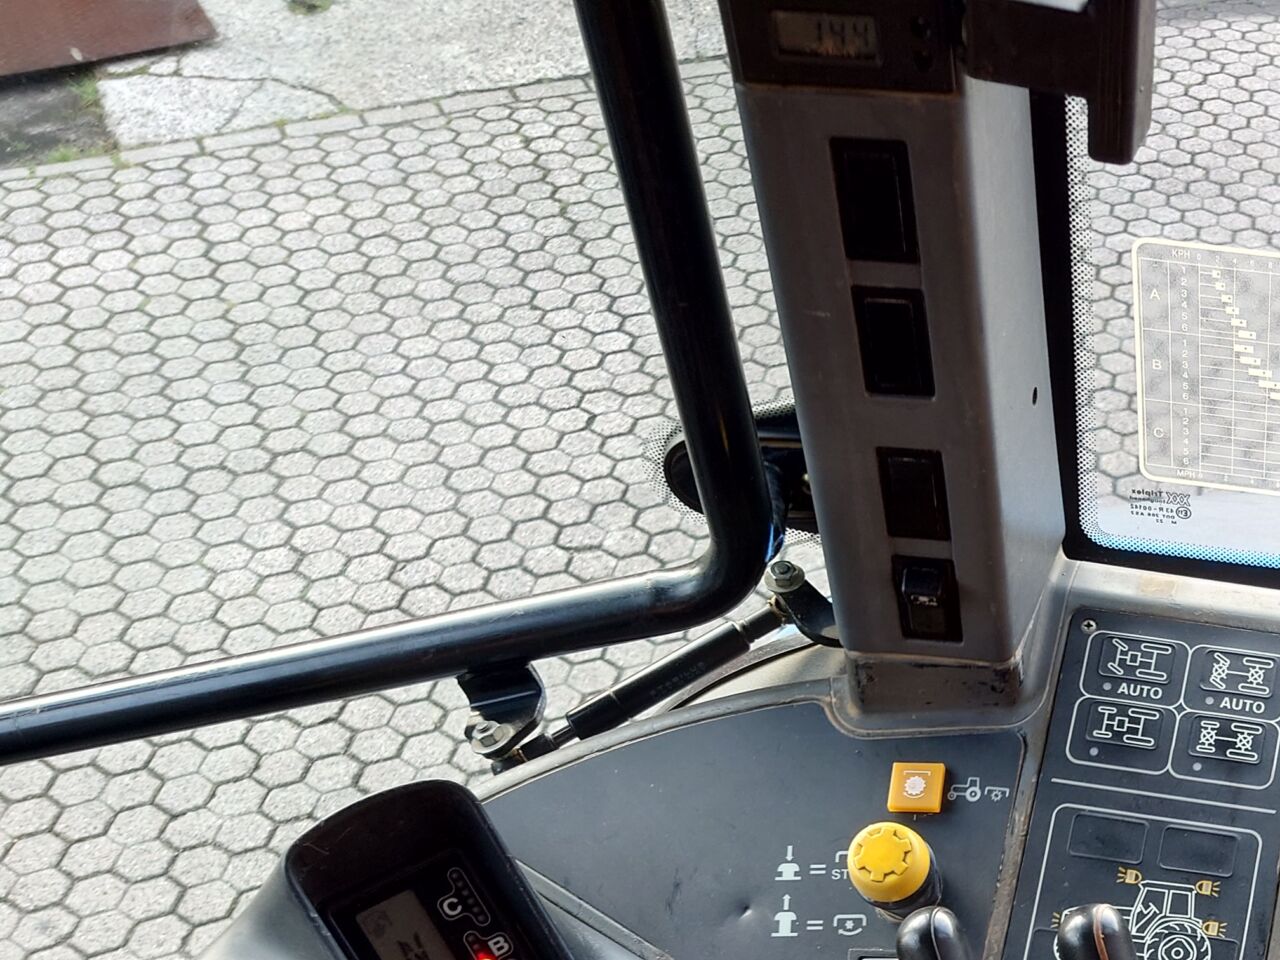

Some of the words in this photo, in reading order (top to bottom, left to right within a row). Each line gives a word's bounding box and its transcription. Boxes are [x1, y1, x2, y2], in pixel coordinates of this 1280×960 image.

[1171, 248, 1191, 260] KPH
[1181, 278, 1188, 286] 2
[1150, 288, 1160, 300] A
[1181, 290, 1188, 298] 3
[1181, 300, 1188, 308] 4
[1182, 312, 1188, 320] 5
[1182, 323, 1188, 332] 6
[1182, 350, 1188, 358] 2
[1152, 358, 1162, 370] B
[1182, 360, 1188, 368] 3
[1182, 382, 1189, 390] 5
[1182, 392, 1189, 400] 6
[1182, 417, 1189, 425] 2
[1153, 428, 1164, 438] C
[1182, 428, 1190, 436] 3
[1182, 448, 1189, 456] 5
[1182, 457, 1190, 465] 6
[1176, 469, 1196, 478] MPH
[1117, 682, 1162, 700] AUTO
[1220, 697, 1266, 714] AUTO
[831, 868, 849, 880] ST
[442, 897, 462, 916] C
[488, 936, 510, 957] B
